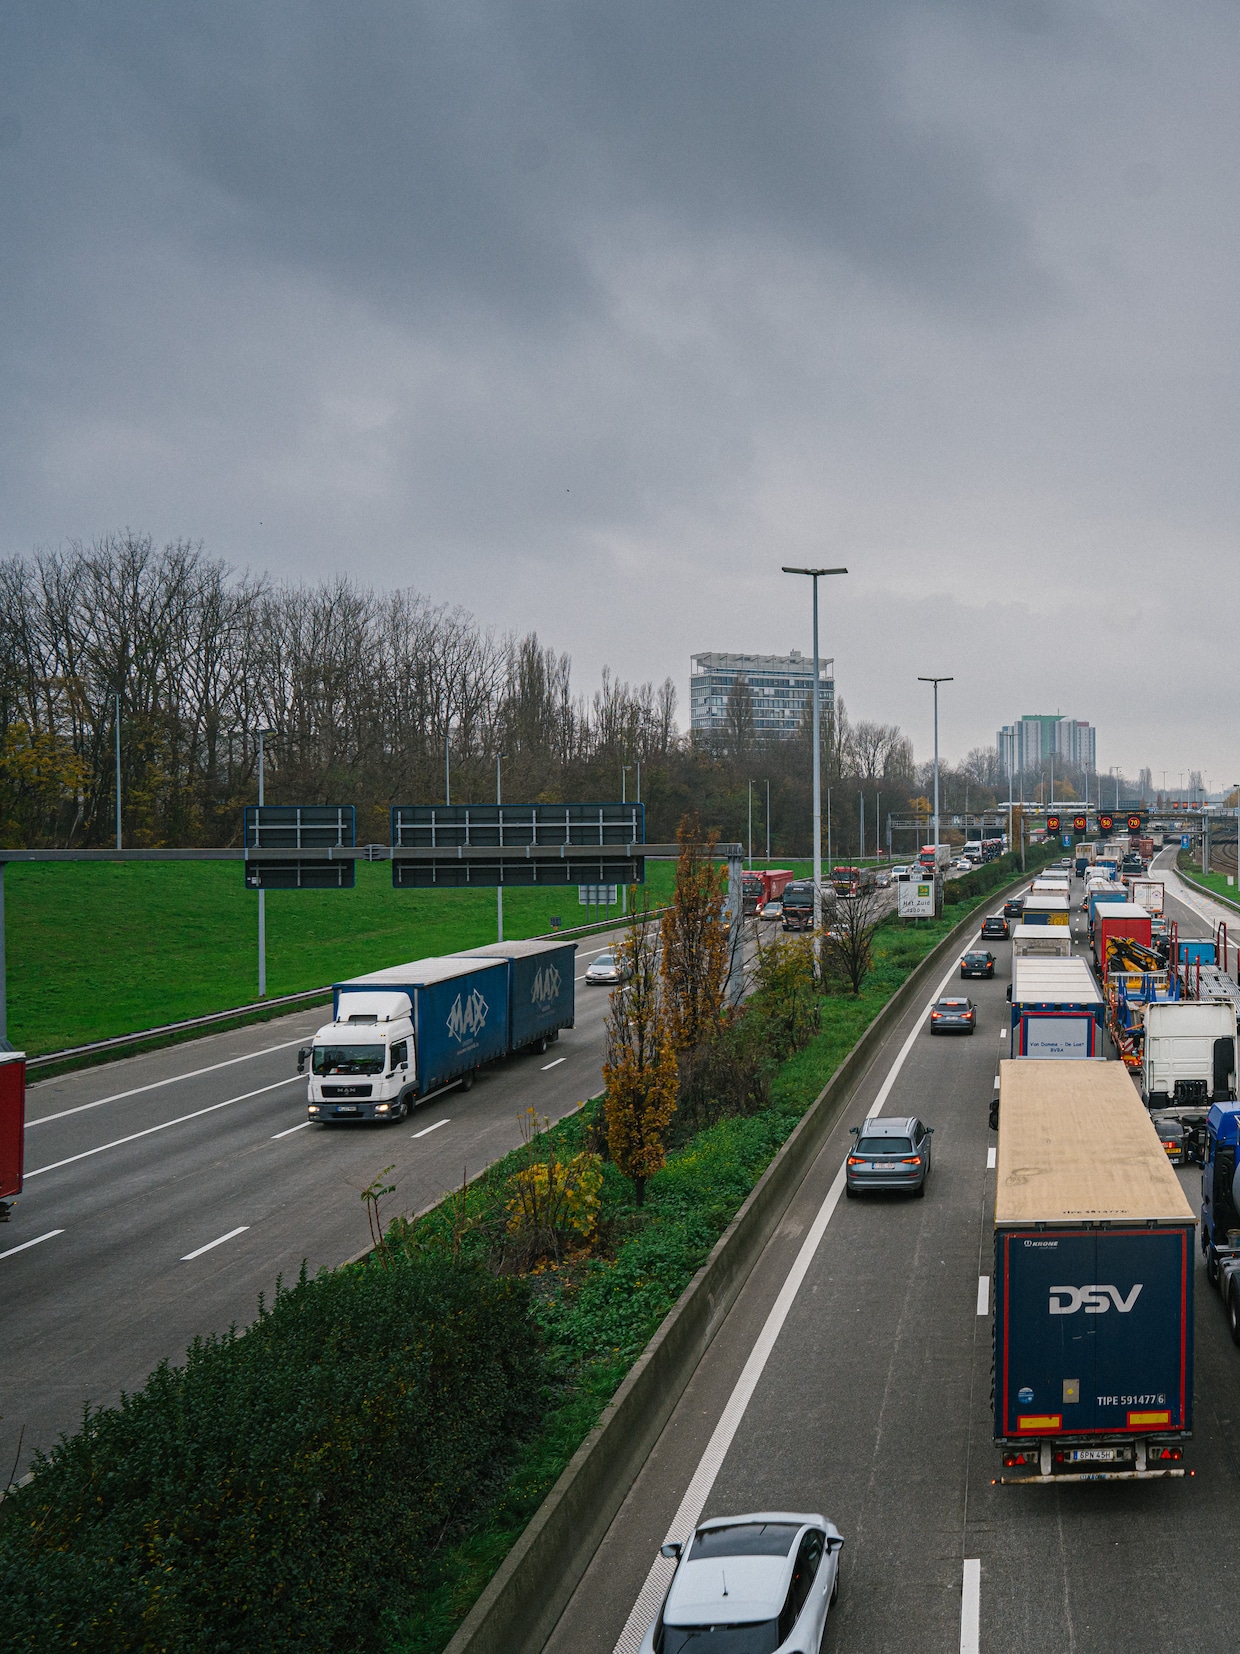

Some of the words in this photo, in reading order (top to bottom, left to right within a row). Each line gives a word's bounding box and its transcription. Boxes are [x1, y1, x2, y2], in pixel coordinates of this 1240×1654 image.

[532, 969, 559, 1003] MAX
[448, 995, 486, 1037] MAX
[1050, 1284, 1144, 1314] DSV
[1097, 1396, 1118, 1406] TIPE
